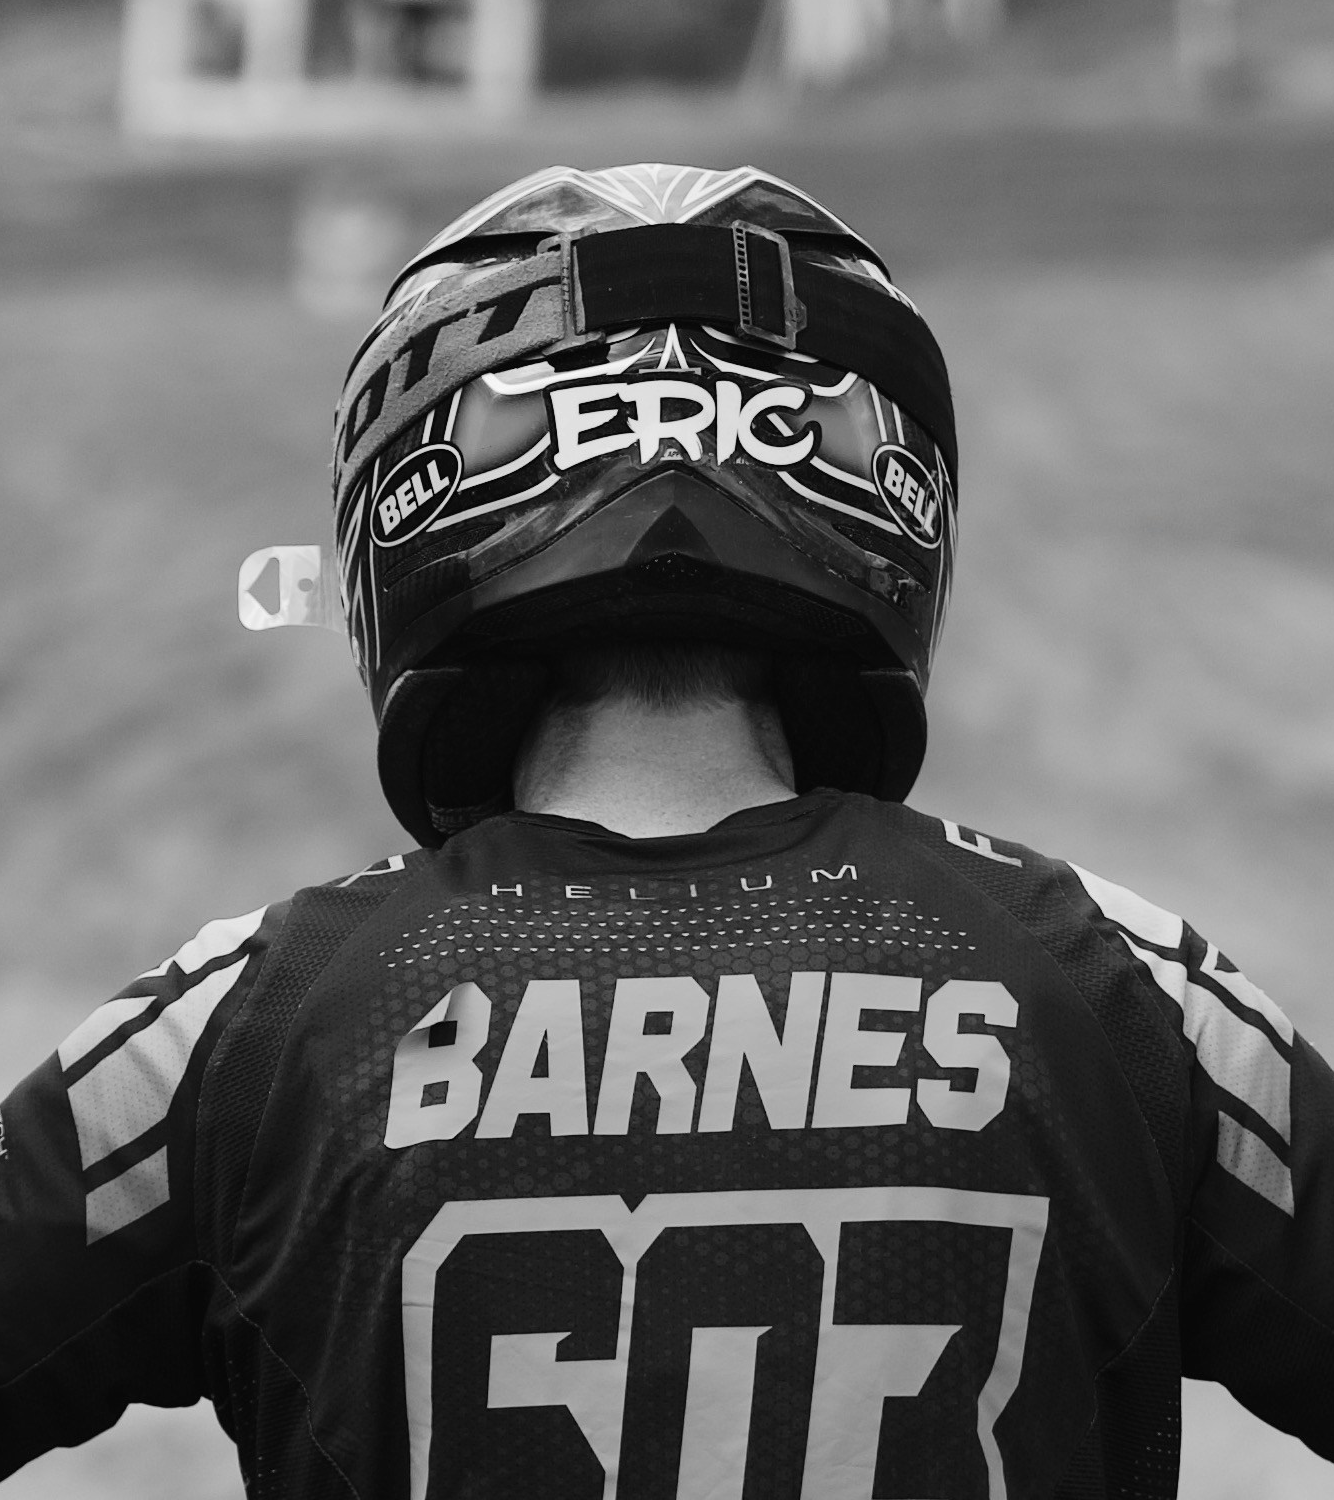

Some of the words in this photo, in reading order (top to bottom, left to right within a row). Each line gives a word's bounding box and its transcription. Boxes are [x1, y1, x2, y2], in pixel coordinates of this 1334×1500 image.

[551, 379, 815, 470] ERIC
[378, 459, 450, 536] BELL
[883, 456, 937, 539] BELL
[490, 863, 858, 901] HELIUM
[383, 971, 1020, 1150] BARNES
